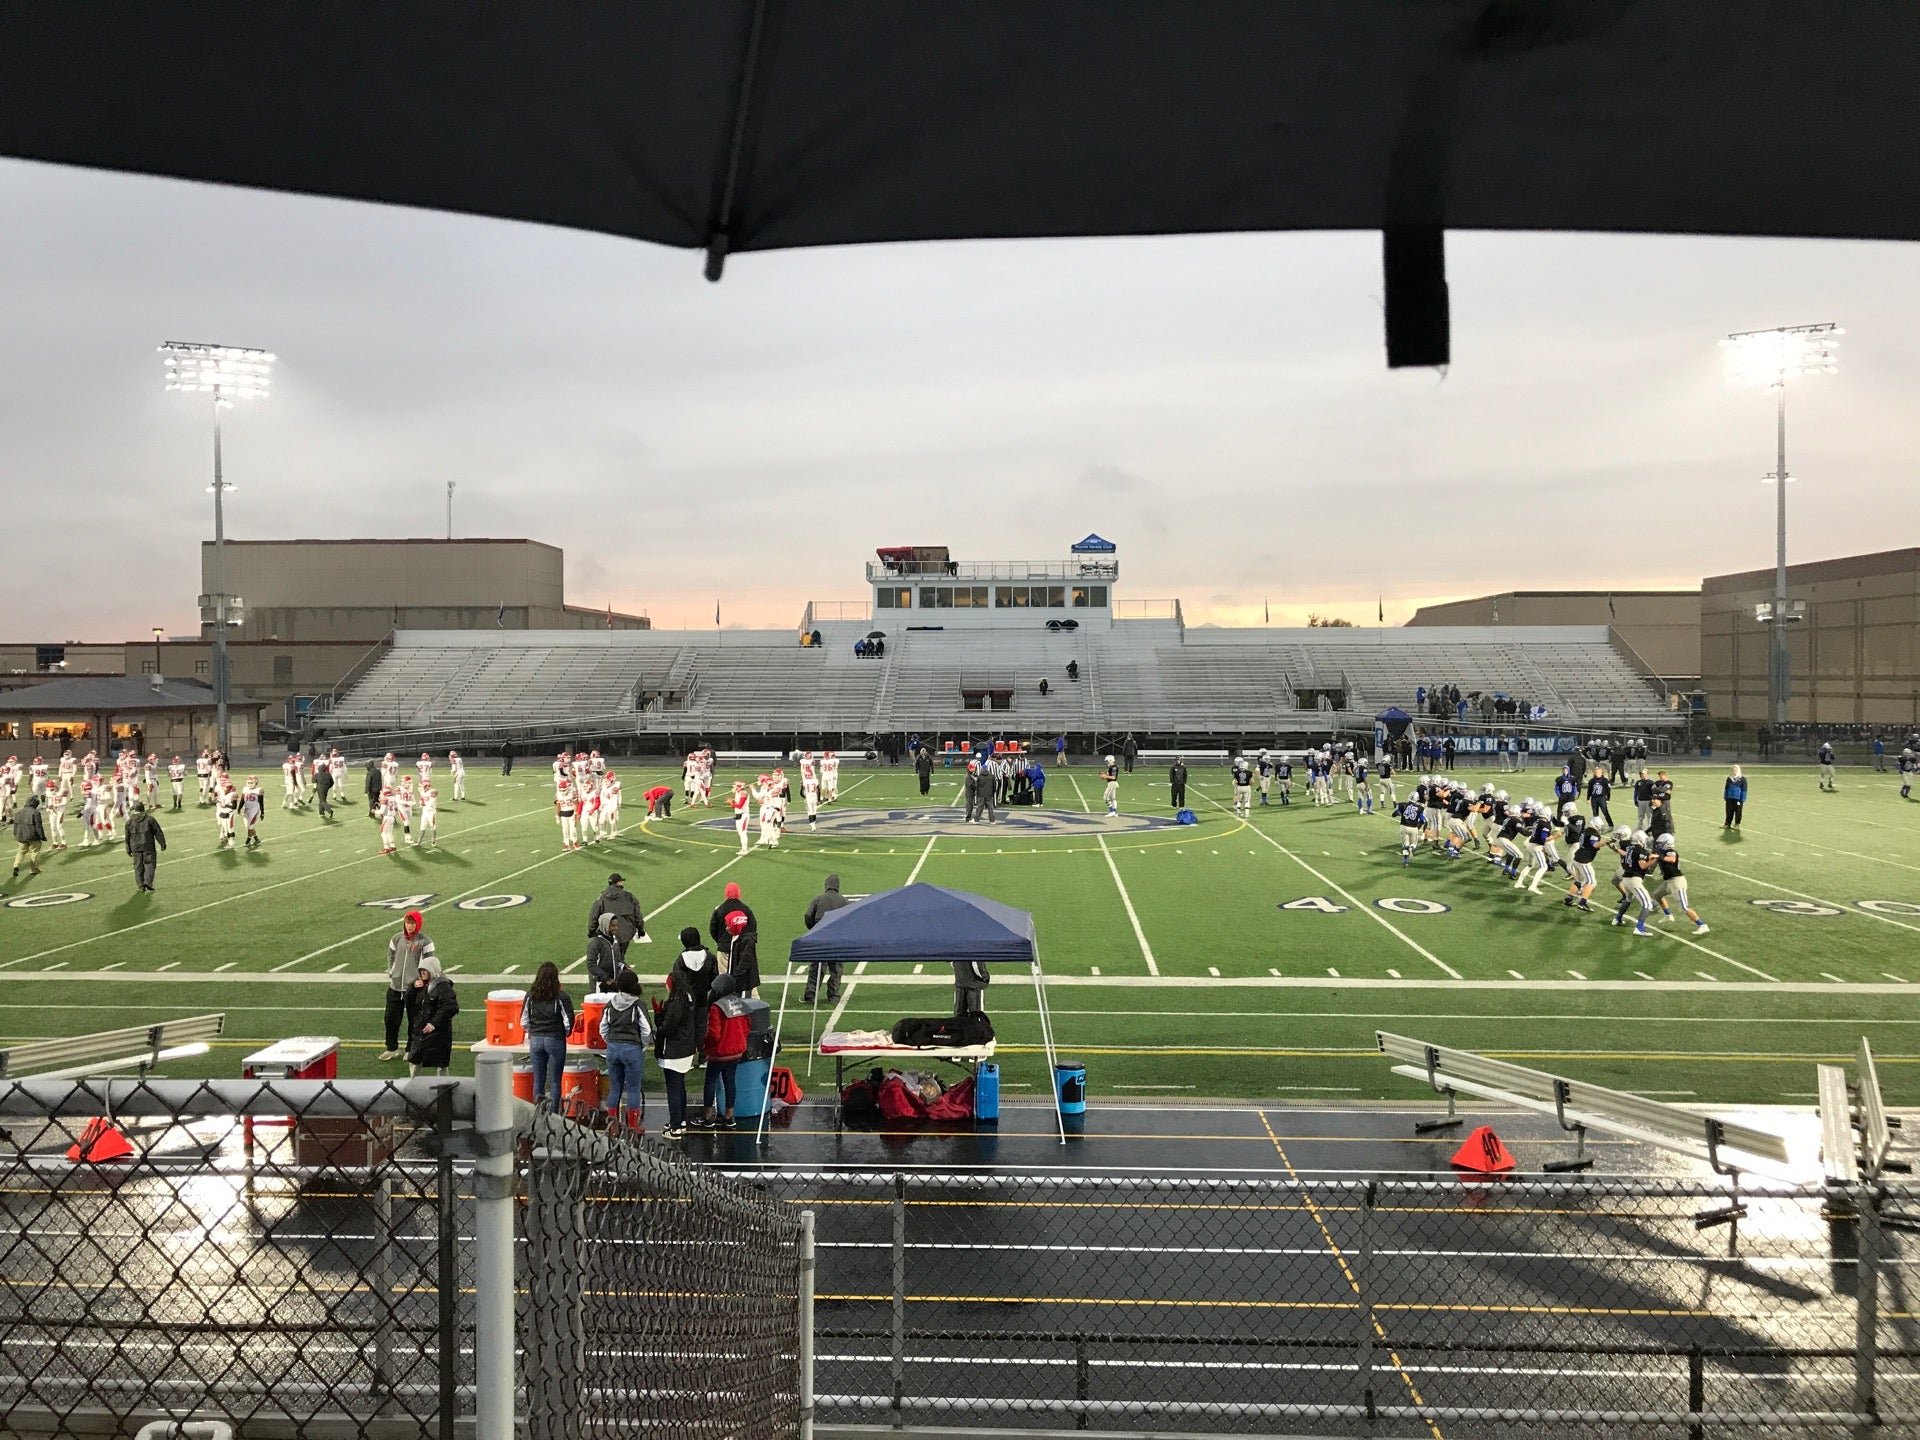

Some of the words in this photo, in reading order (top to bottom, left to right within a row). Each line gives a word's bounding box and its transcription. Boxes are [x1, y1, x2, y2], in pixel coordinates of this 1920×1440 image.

[1436, 737, 1481, 751] YALS
[1521, 737, 1556, 751] REW
[1403, 805, 1418, 820] 45
[770, 1071, 790, 1099] 50
[1482, 1132, 1502, 1165] 40
